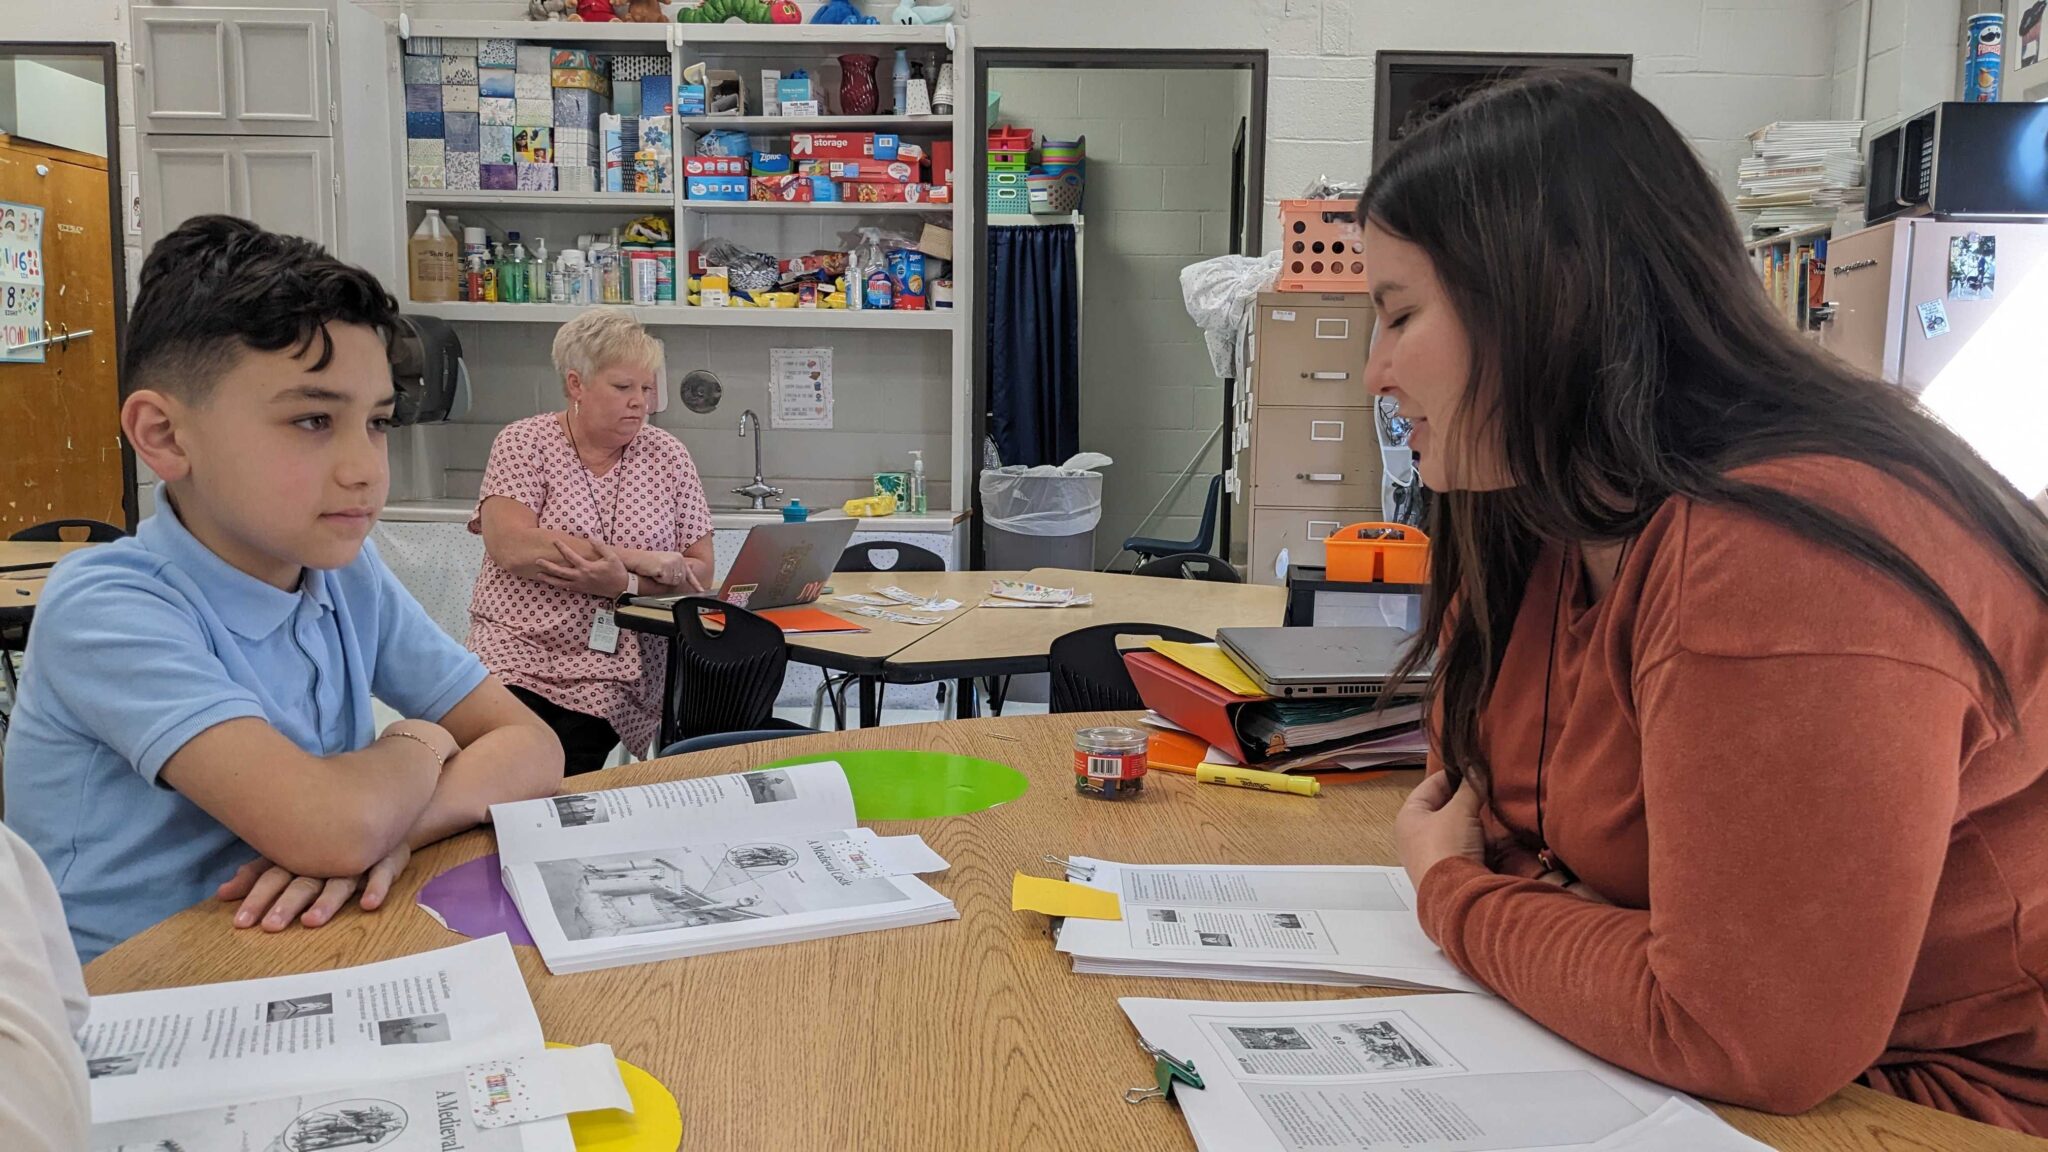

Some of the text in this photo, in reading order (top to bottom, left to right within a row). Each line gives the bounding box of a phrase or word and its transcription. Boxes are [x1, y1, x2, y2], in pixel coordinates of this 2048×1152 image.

[814, 139, 848, 148] storage
[19, 252, 27, 271] 6
[7, 286, 15, 308] 8
[811, 845, 840, 872] Medieval
[831, 871, 853, 887] Castle
[436, 1091, 465, 1152] A Medieval
